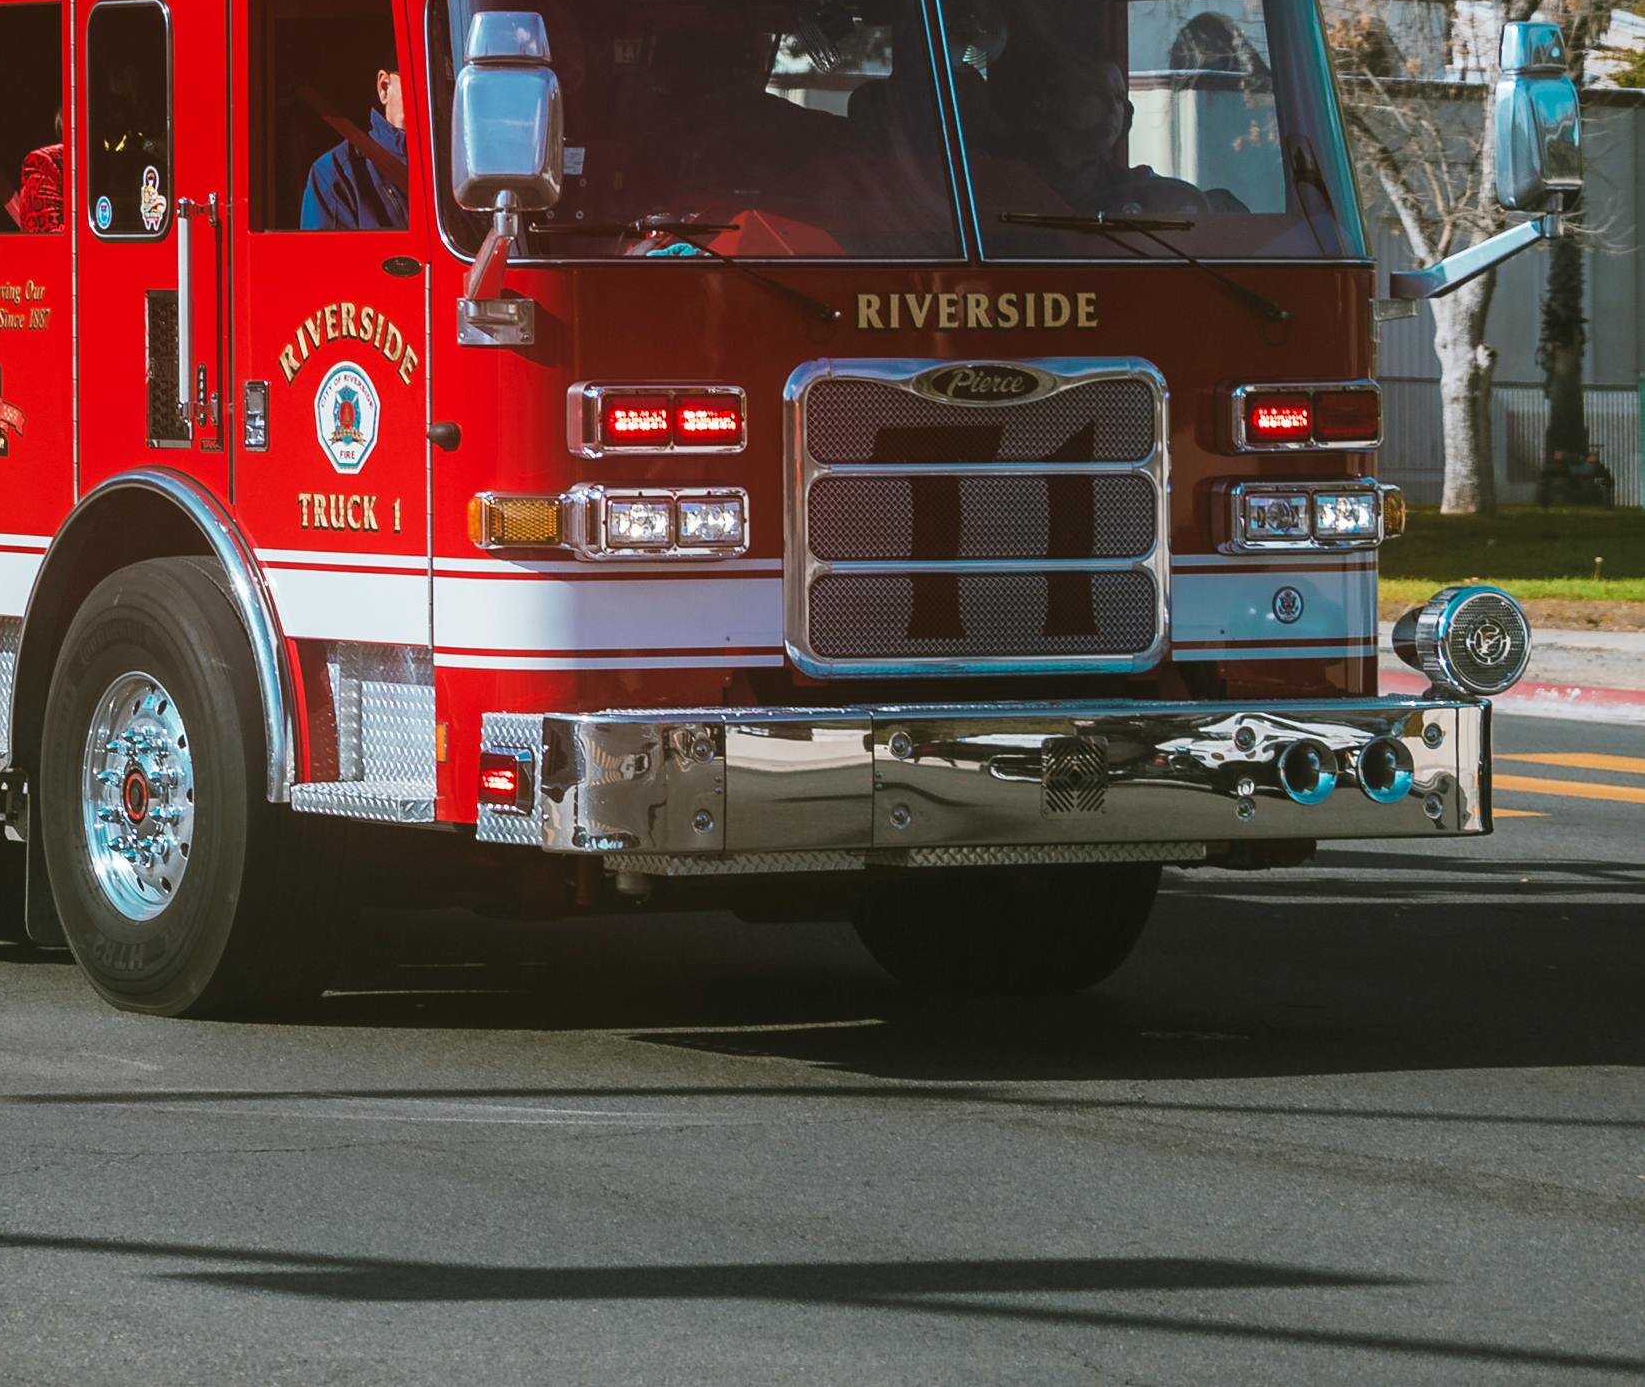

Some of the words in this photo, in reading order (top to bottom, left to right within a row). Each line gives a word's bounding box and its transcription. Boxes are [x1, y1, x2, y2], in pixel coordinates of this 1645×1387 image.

[24, 279, 46, 300] Our
[29, 308, 51, 329] 1887
[856, 292, 1099, 329] RIVERSIDE
[279, 302, 419, 385] RIVERSIDE
[320, 382, 333, 408] CITY
[333, 375, 343, 386] OF
[343, 374, 374, 409] RIVERSIDE
[947, 368, 1025, 396] Pierce
[339, 450, 356, 460] FIRE
[298, 493, 378, 530] TRUCK
[390, 496, 403, 533] 1
